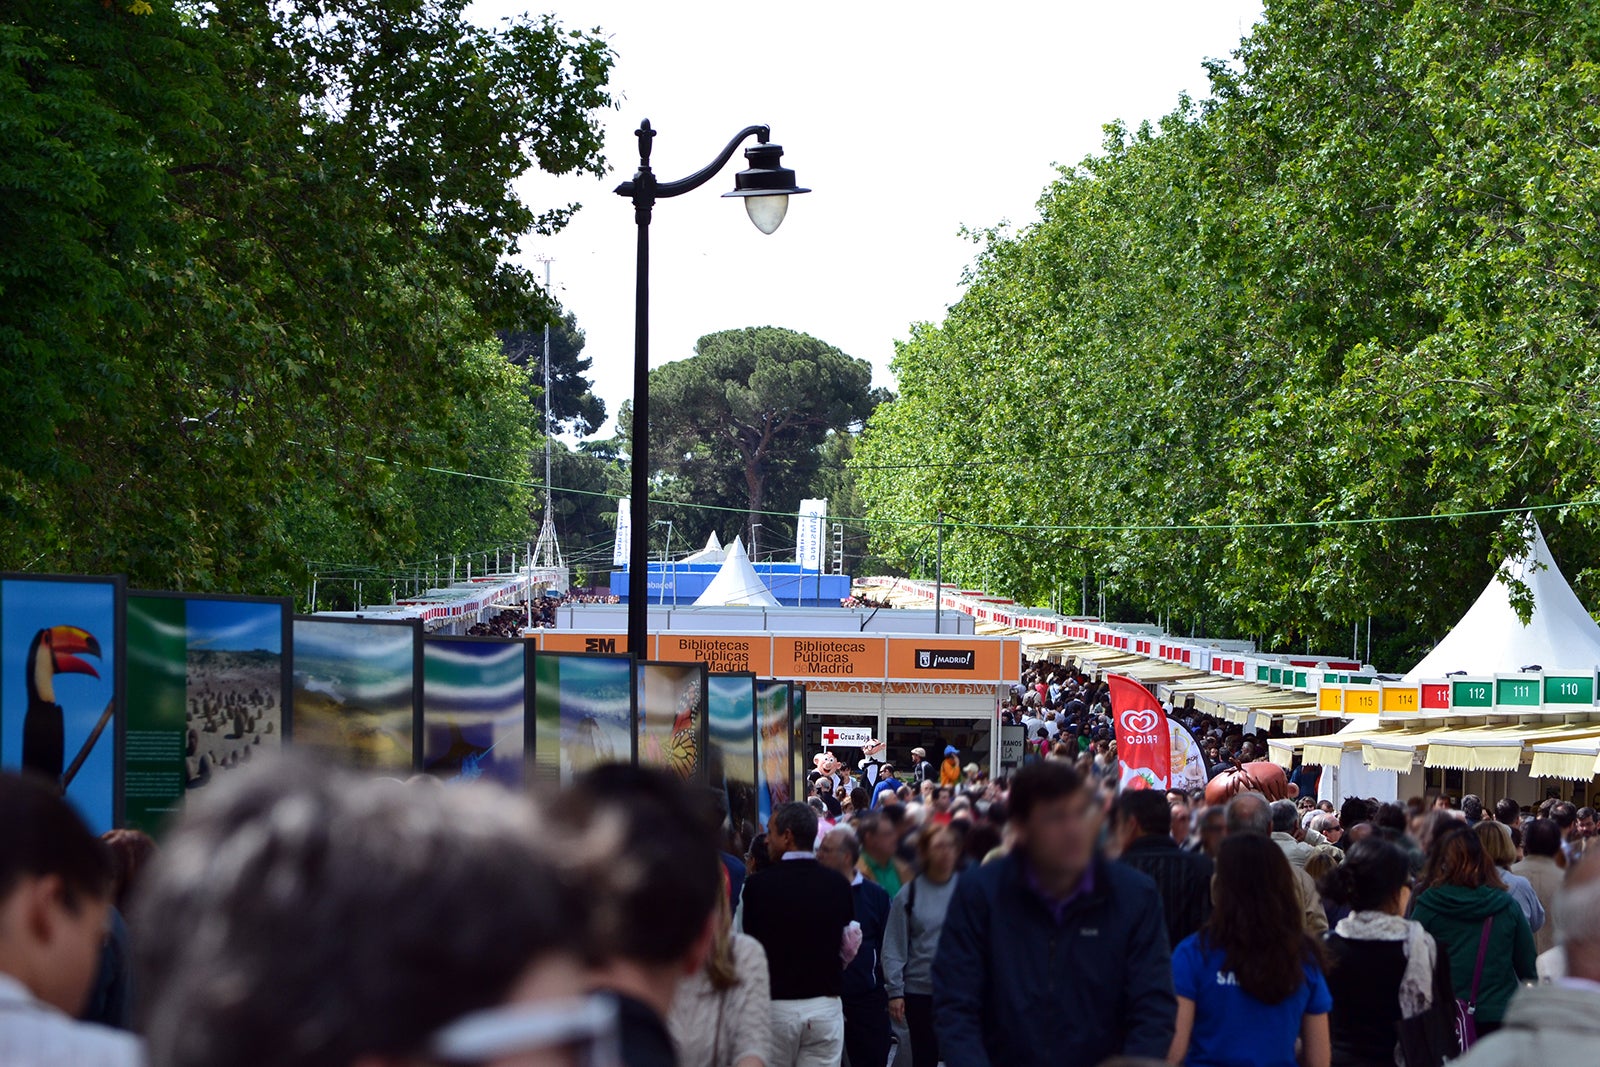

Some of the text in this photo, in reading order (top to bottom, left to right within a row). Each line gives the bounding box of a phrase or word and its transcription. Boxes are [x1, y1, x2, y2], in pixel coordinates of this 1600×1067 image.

[678, 639, 749, 651] Bibliotecas
[794, 640, 866, 652] Bibliotecas
[695, 649, 749, 661] Públicas
[794, 650, 849, 663] Públicas
[1469, 687, 1485, 699] 112
[1513, 685, 1529, 697] 111
[1561, 683, 1578, 695] 110
[1359, 696, 1373, 706] 115
[1398, 695, 1413, 704] 114
[840, 732, 870, 742] Cruz Roja
[1216, 971, 1239, 985] SA
